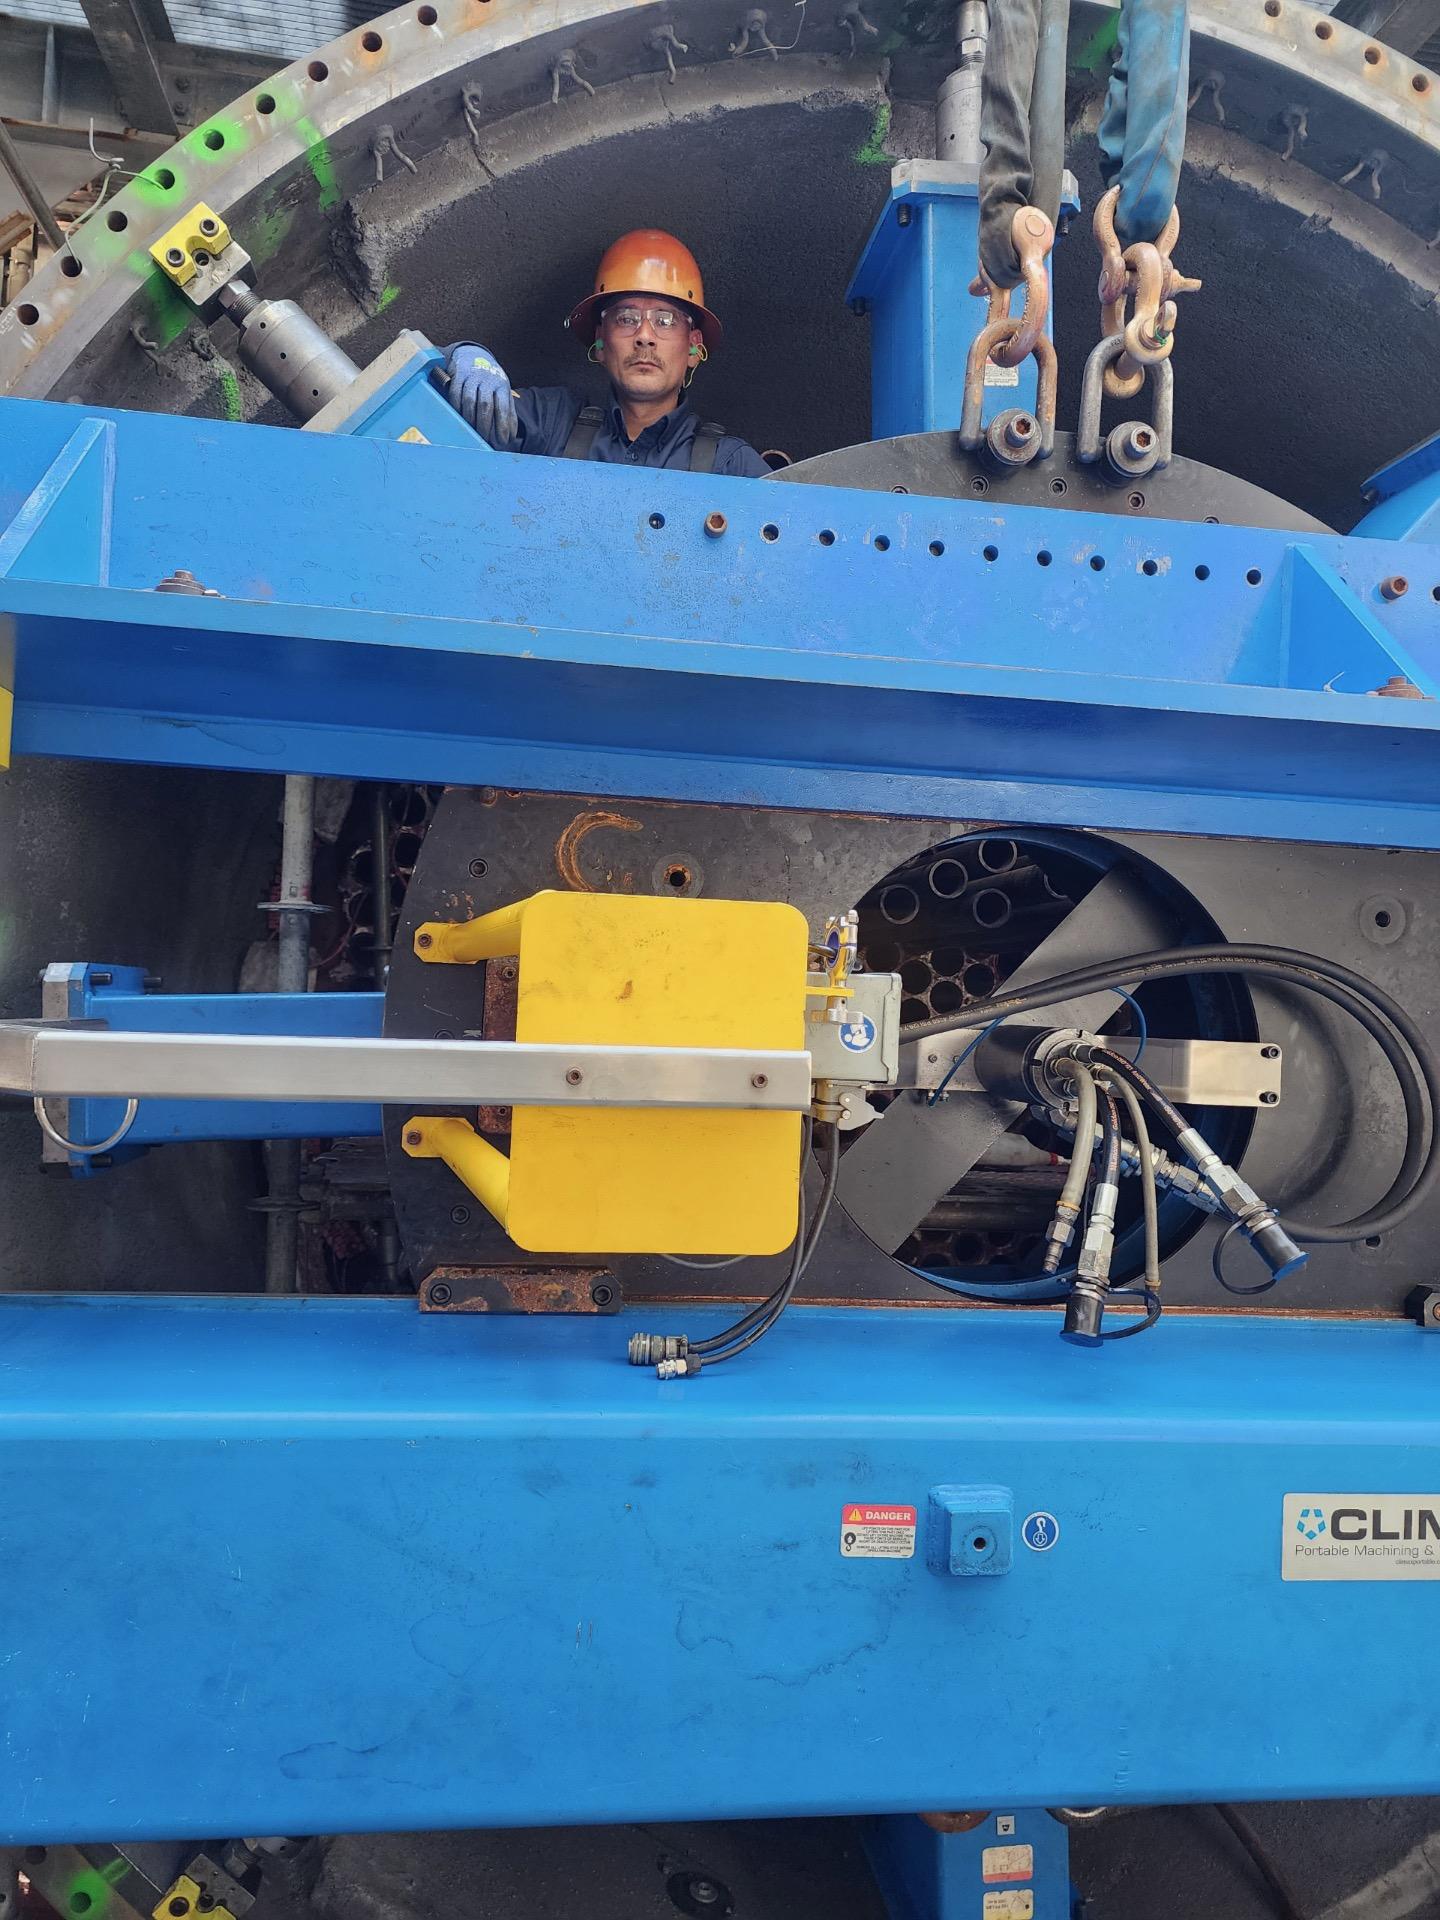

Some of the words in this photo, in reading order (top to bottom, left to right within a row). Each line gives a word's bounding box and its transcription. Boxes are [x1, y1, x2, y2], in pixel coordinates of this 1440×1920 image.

[865, 1511, 911, 1520] DANGER
[1295, 1545, 1350, 1556] Portable
[1354, 1545, 1419, 1558] Machining
[1424, 1545, 1434, 1556] &
